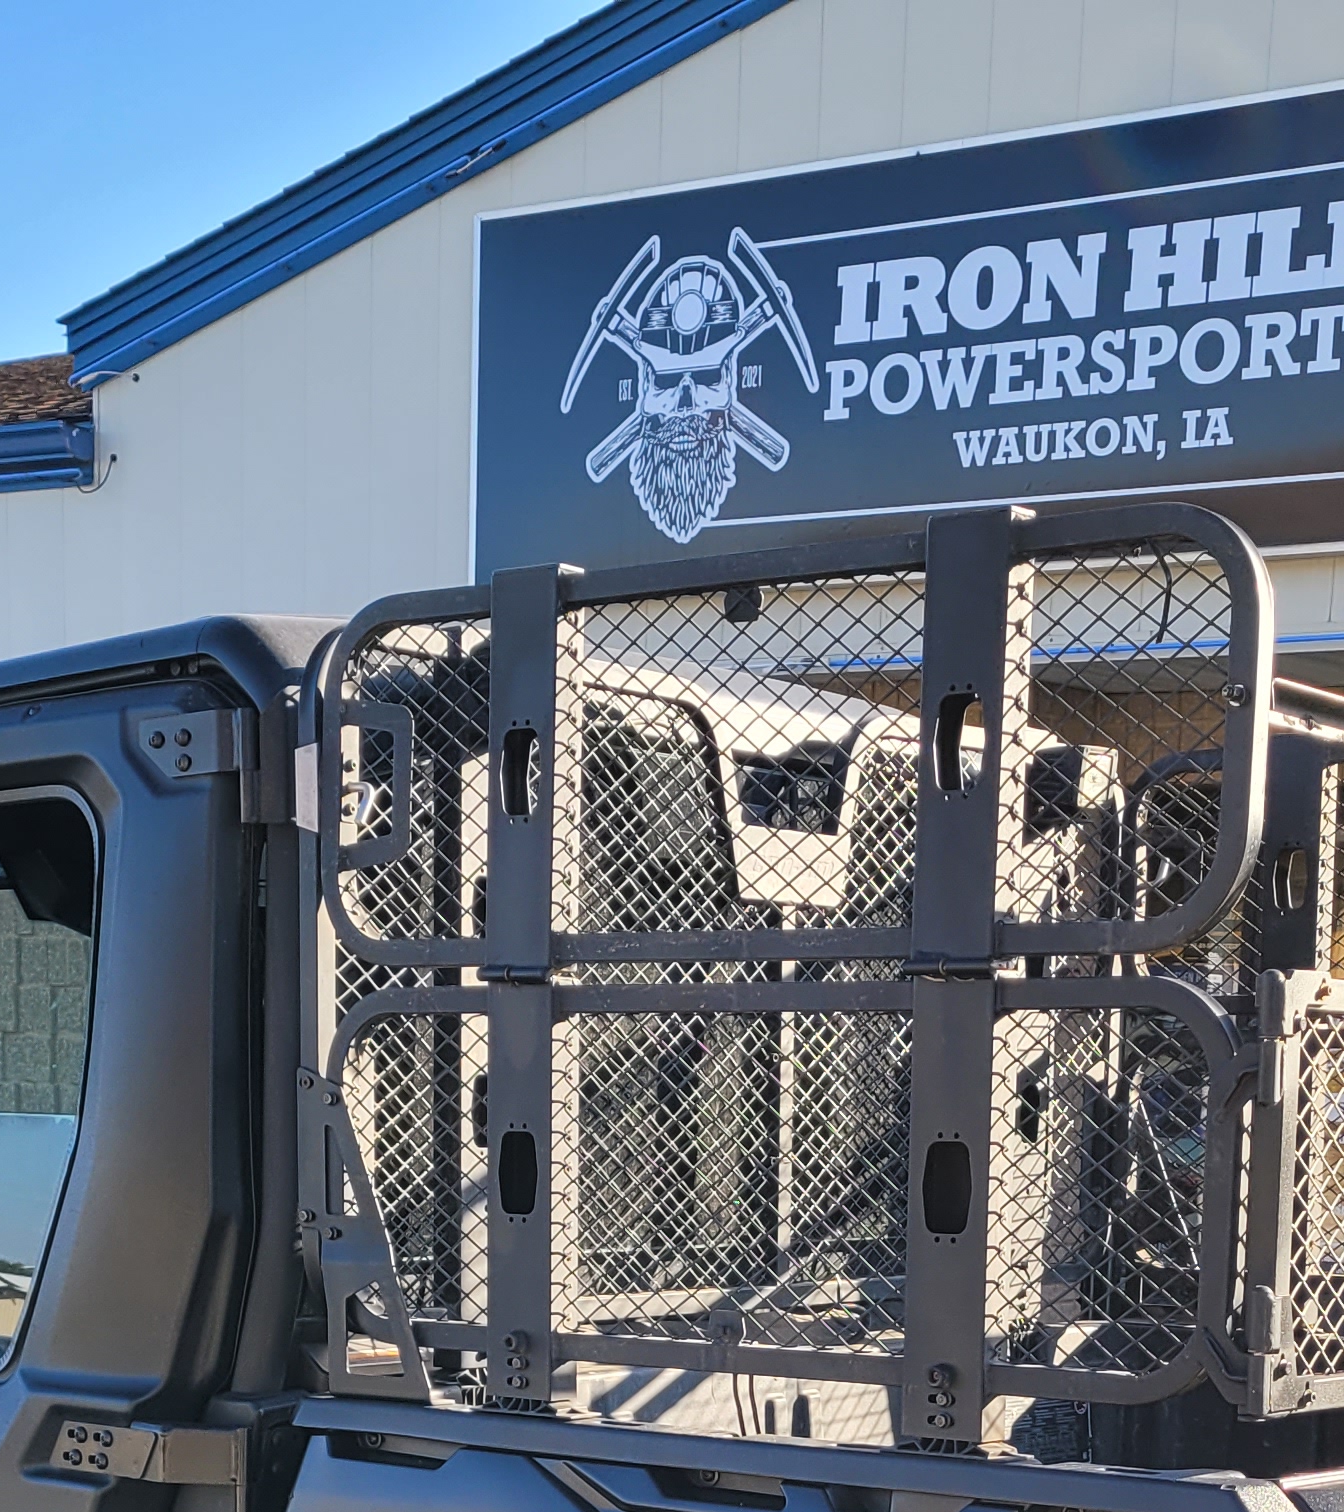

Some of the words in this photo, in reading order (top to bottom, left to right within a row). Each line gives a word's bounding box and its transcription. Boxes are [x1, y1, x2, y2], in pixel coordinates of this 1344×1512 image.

[834, 232, 1107, 345] IRON
[618, 379, 634, 402] EST.
[741, 365, 763, 388] 2021
[953, 414, 1166, 468] WAUKON,
[1180, 407, 1234, 449] IA
